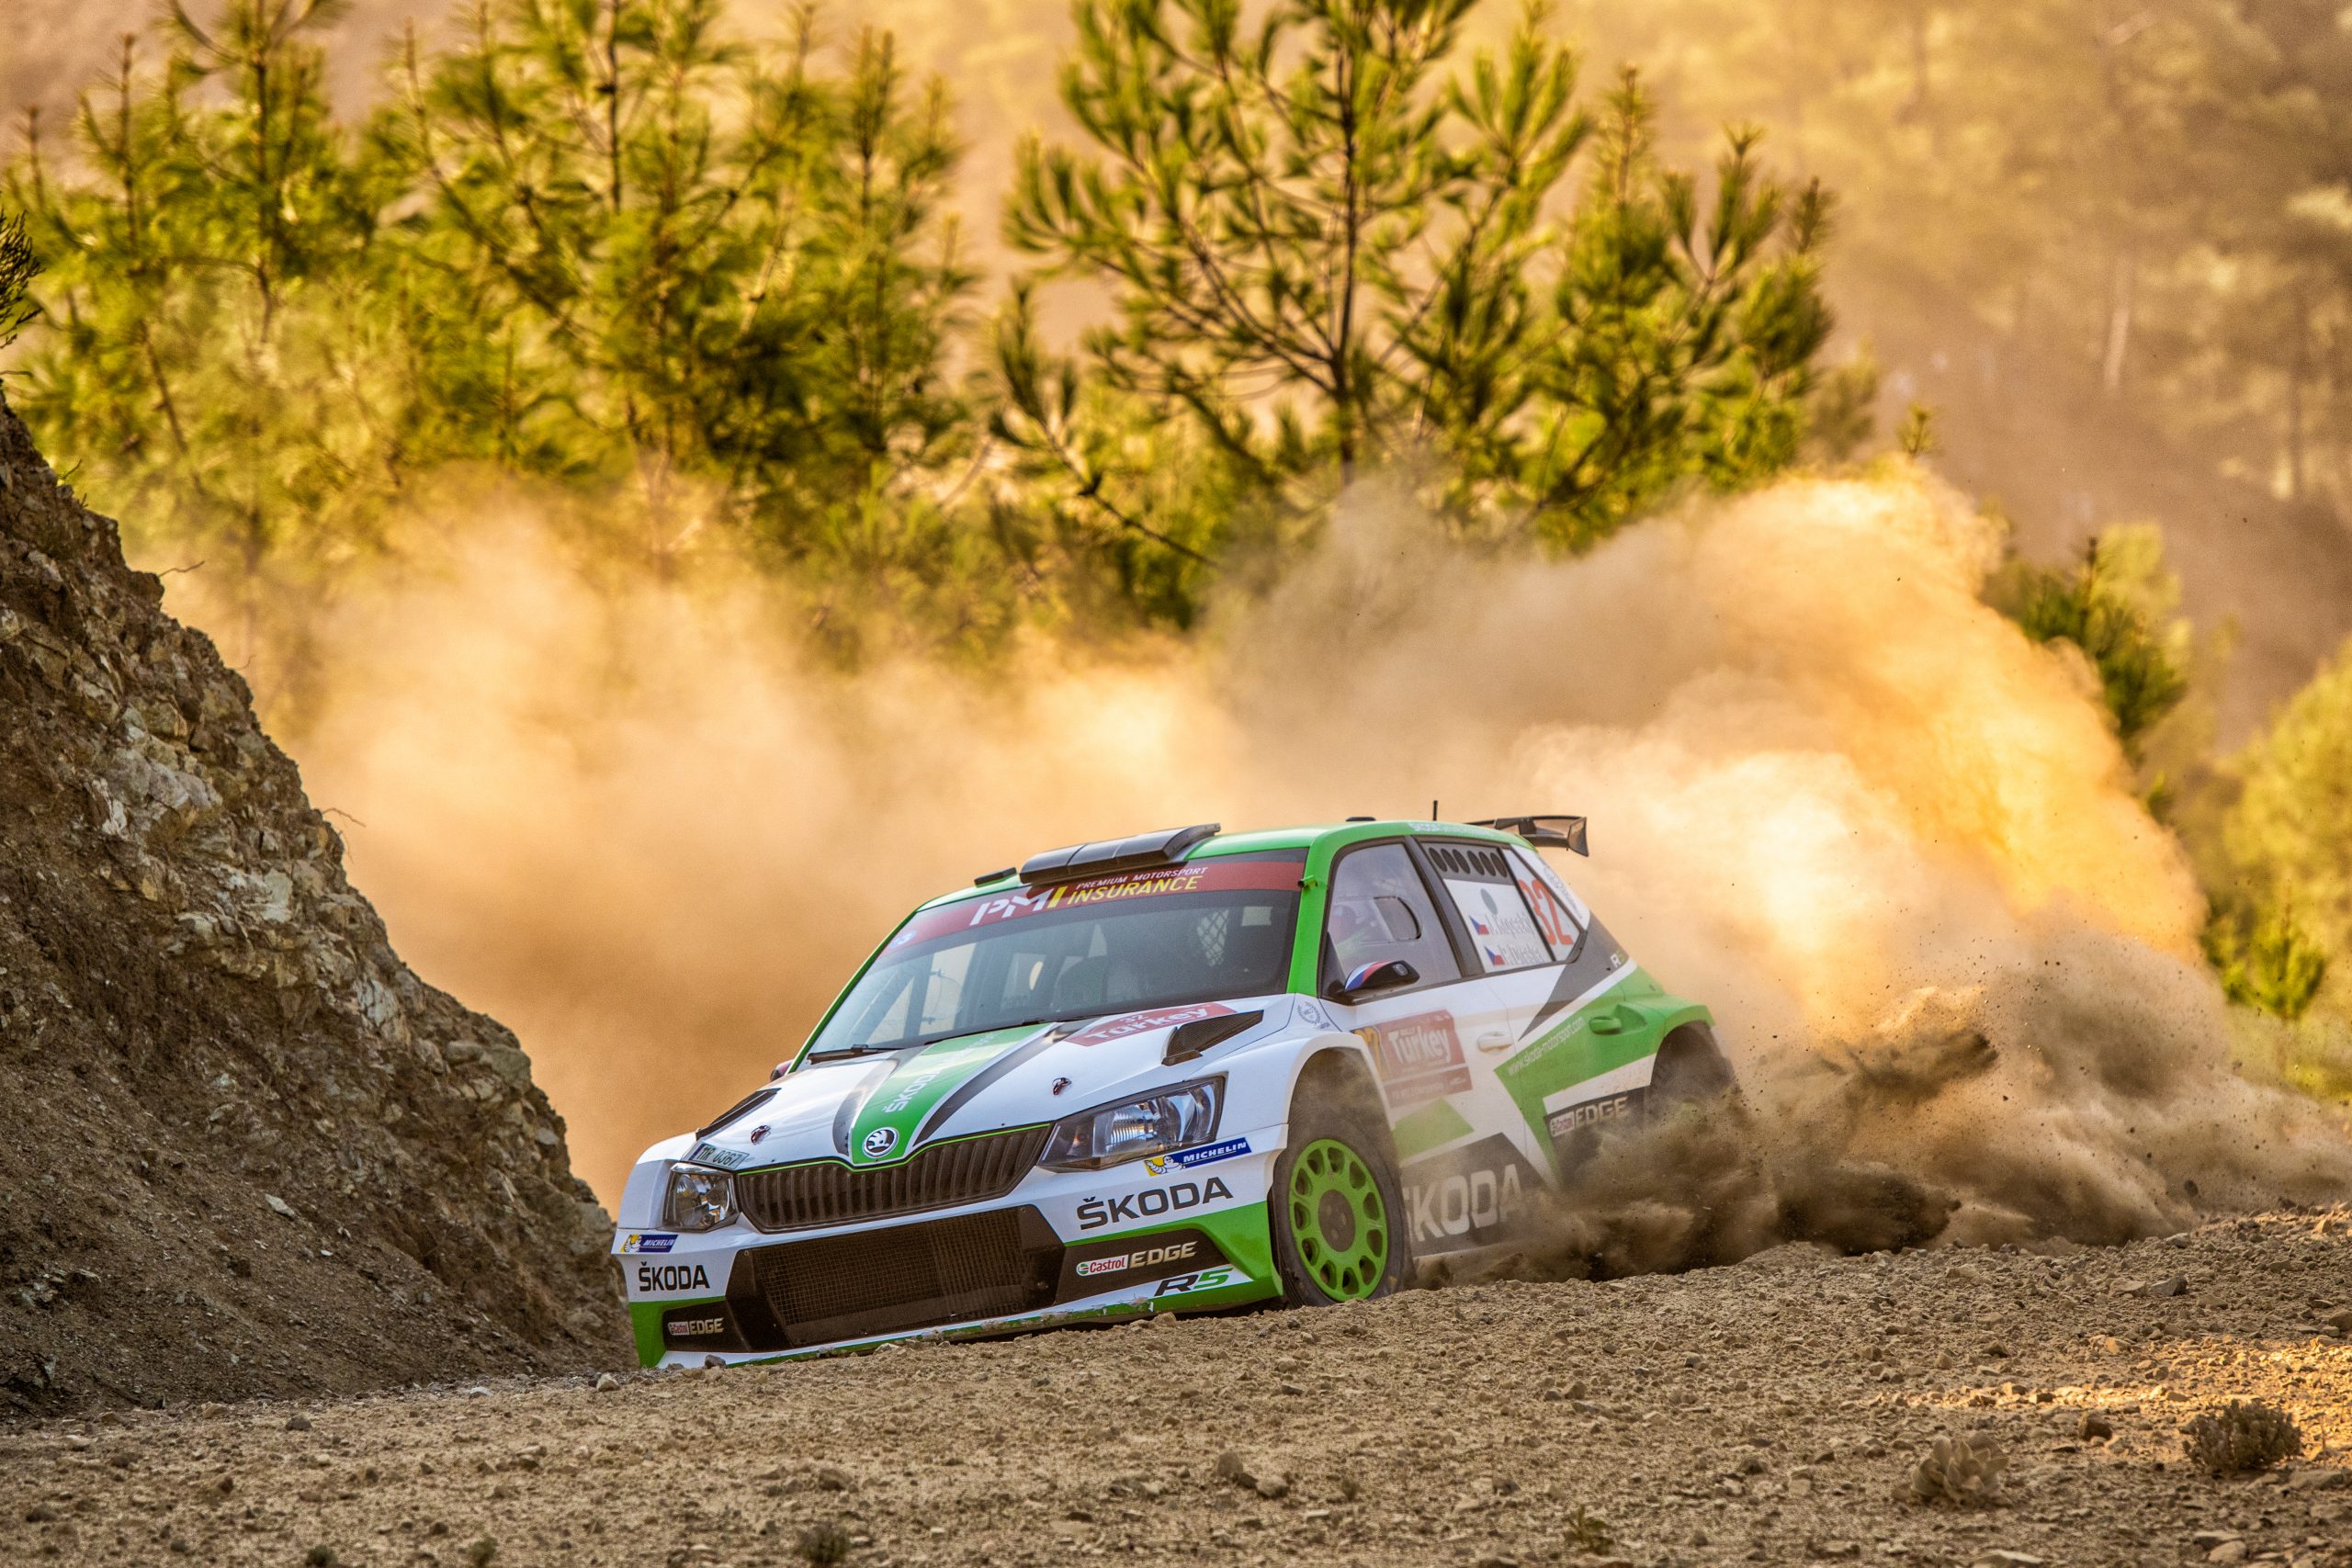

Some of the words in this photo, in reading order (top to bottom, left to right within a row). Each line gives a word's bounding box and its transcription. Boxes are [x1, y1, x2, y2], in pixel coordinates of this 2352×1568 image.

[1068, 875, 1204, 905] INSURANCE
[1076, 876, 1127, 889] PREMIUM
[1132, 867, 1208, 881] MOTORSPORT
[1518, 879, 1574, 945] 32
[1085, 1008, 1208, 1039] Turkey
[1387, 1025, 1451, 1064] Turkey
[1576, 1096, 1628, 1128] EDGE
[713, 1150, 742, 1166] 0367
[1183, 1142, 1247, 1163] MICHELIN
[1076, 1177, 1233, 1230] ŠKODA
[643, 1238, 677, 1247] MICHELIN
[1090, 1258, 1125, 1273] Castrol
[1129, 1242, 1198, 1269] EDGE
[638, 1261, 710, 1292] ŠKODA
[1154, 1267, 1235, 1297] R5
[689, 1317, 724, 1335] EDGE
